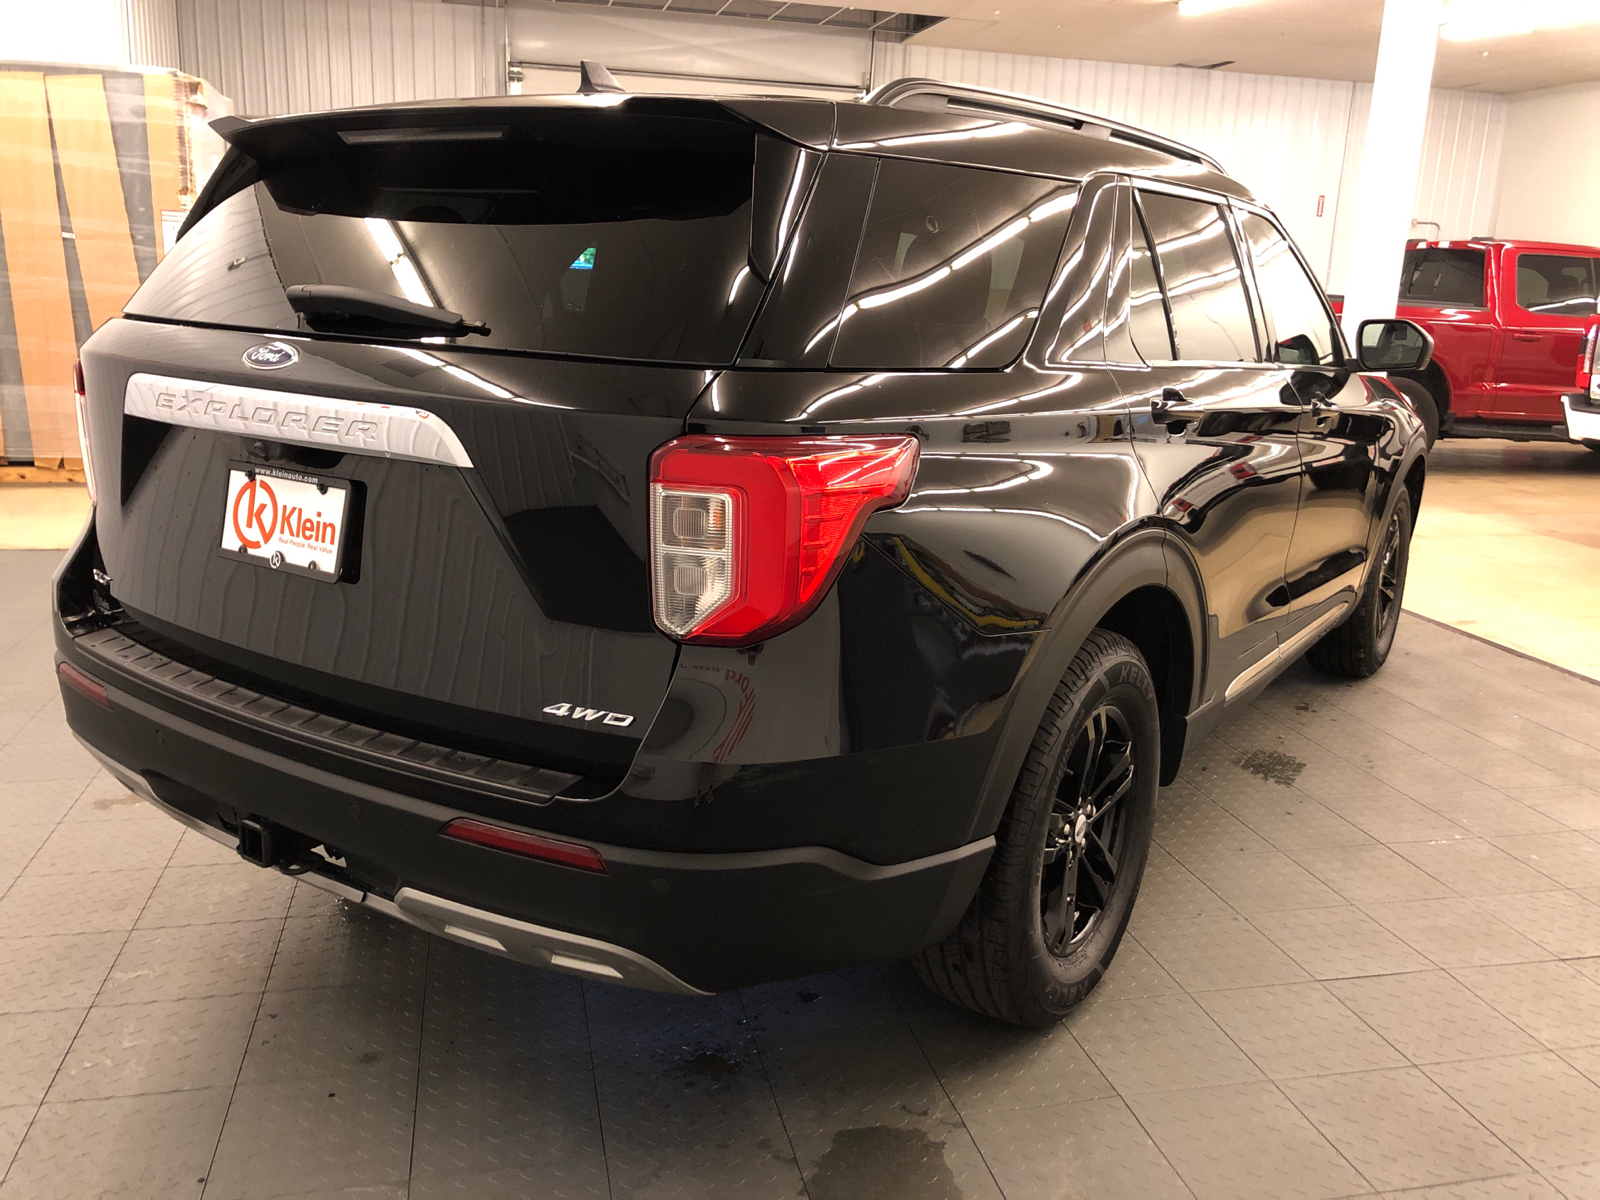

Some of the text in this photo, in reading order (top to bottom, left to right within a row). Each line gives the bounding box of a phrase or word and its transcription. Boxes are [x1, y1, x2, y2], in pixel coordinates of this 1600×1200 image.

[155, 392, 379, 441] EXPLORER
[254, 466, 319, 484] www.kleinauto.com
[279, 504, 336, 546] Klein
[278, 536, 333, 555] Real People Real Value
[542, 702, 636, 728] 4WD
